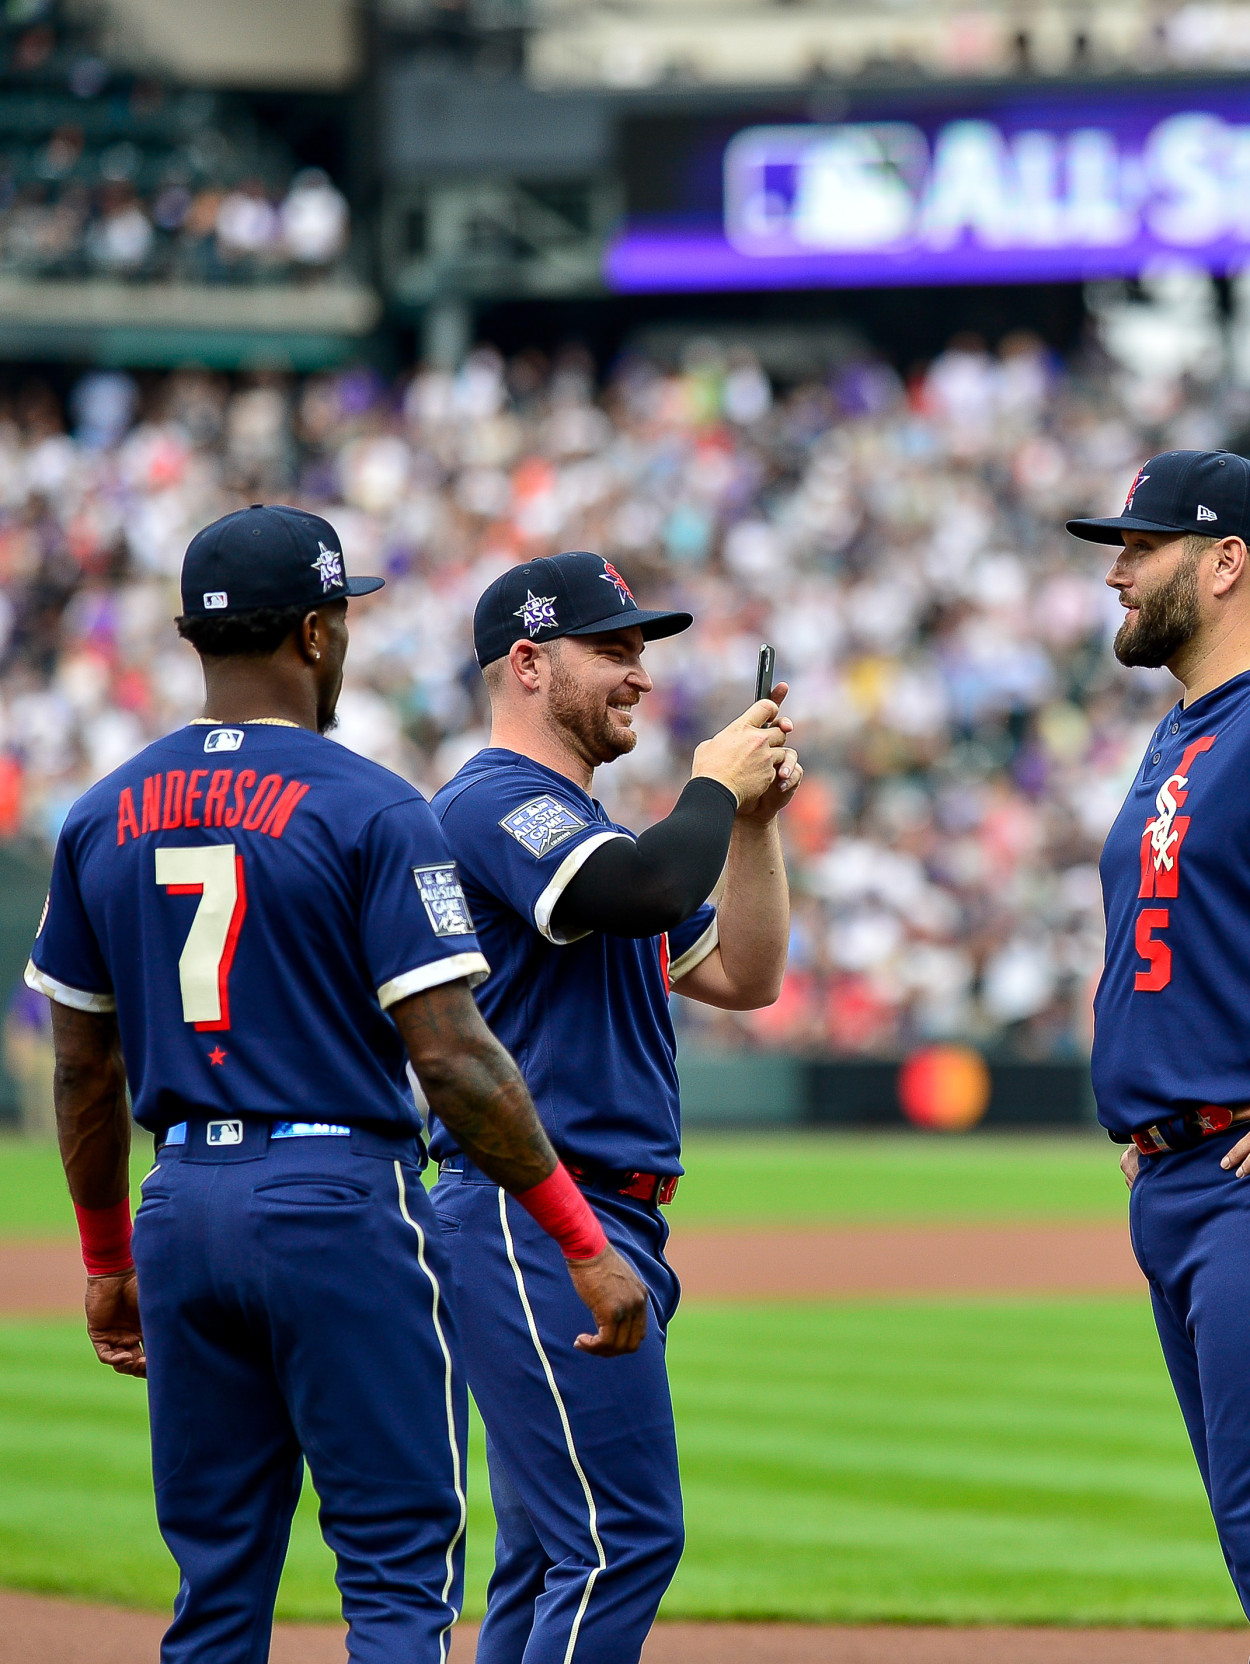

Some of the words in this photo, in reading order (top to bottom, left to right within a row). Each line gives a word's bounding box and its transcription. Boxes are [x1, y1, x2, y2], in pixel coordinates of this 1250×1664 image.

[320, 557, 342, 581] ASG
[523, 602, 556, 627] ASG
[117, 769, 310, 846] ANDERSON
[529, 814, 565, 840] GAME
[155, 843, 247, 1032] 7
